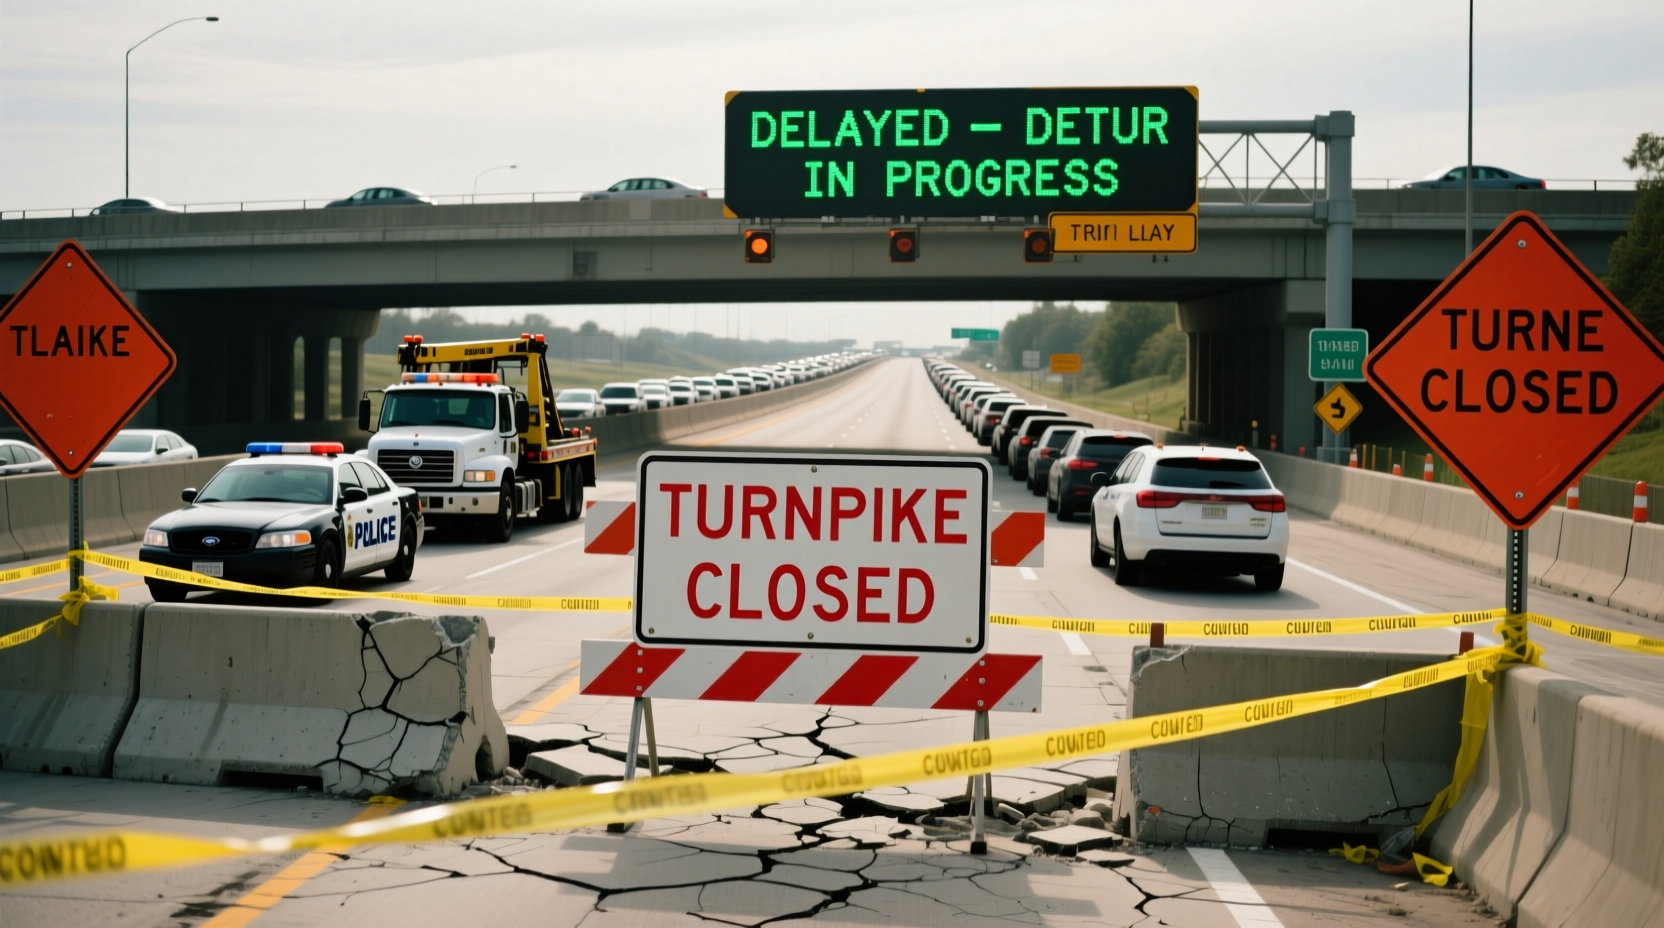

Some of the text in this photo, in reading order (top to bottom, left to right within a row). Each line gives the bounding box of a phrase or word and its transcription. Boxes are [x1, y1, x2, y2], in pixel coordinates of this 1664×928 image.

[751, 109, 949, 148] DELAYED
[1026, 107, 1169, 145] DETUR
[804, 158, 1118, 198] IN PROGRESS
[9, 324, 131, 358] TLAIKE
[1441, 308, 1604, 353] TURNE
[1420, 368, 1619, 415] CLOSED
[354, 514, 396, 550] POLICE
[659, 483, 968, 545] TURNPIKE
[686, 561, 935, 624] CLOSED
